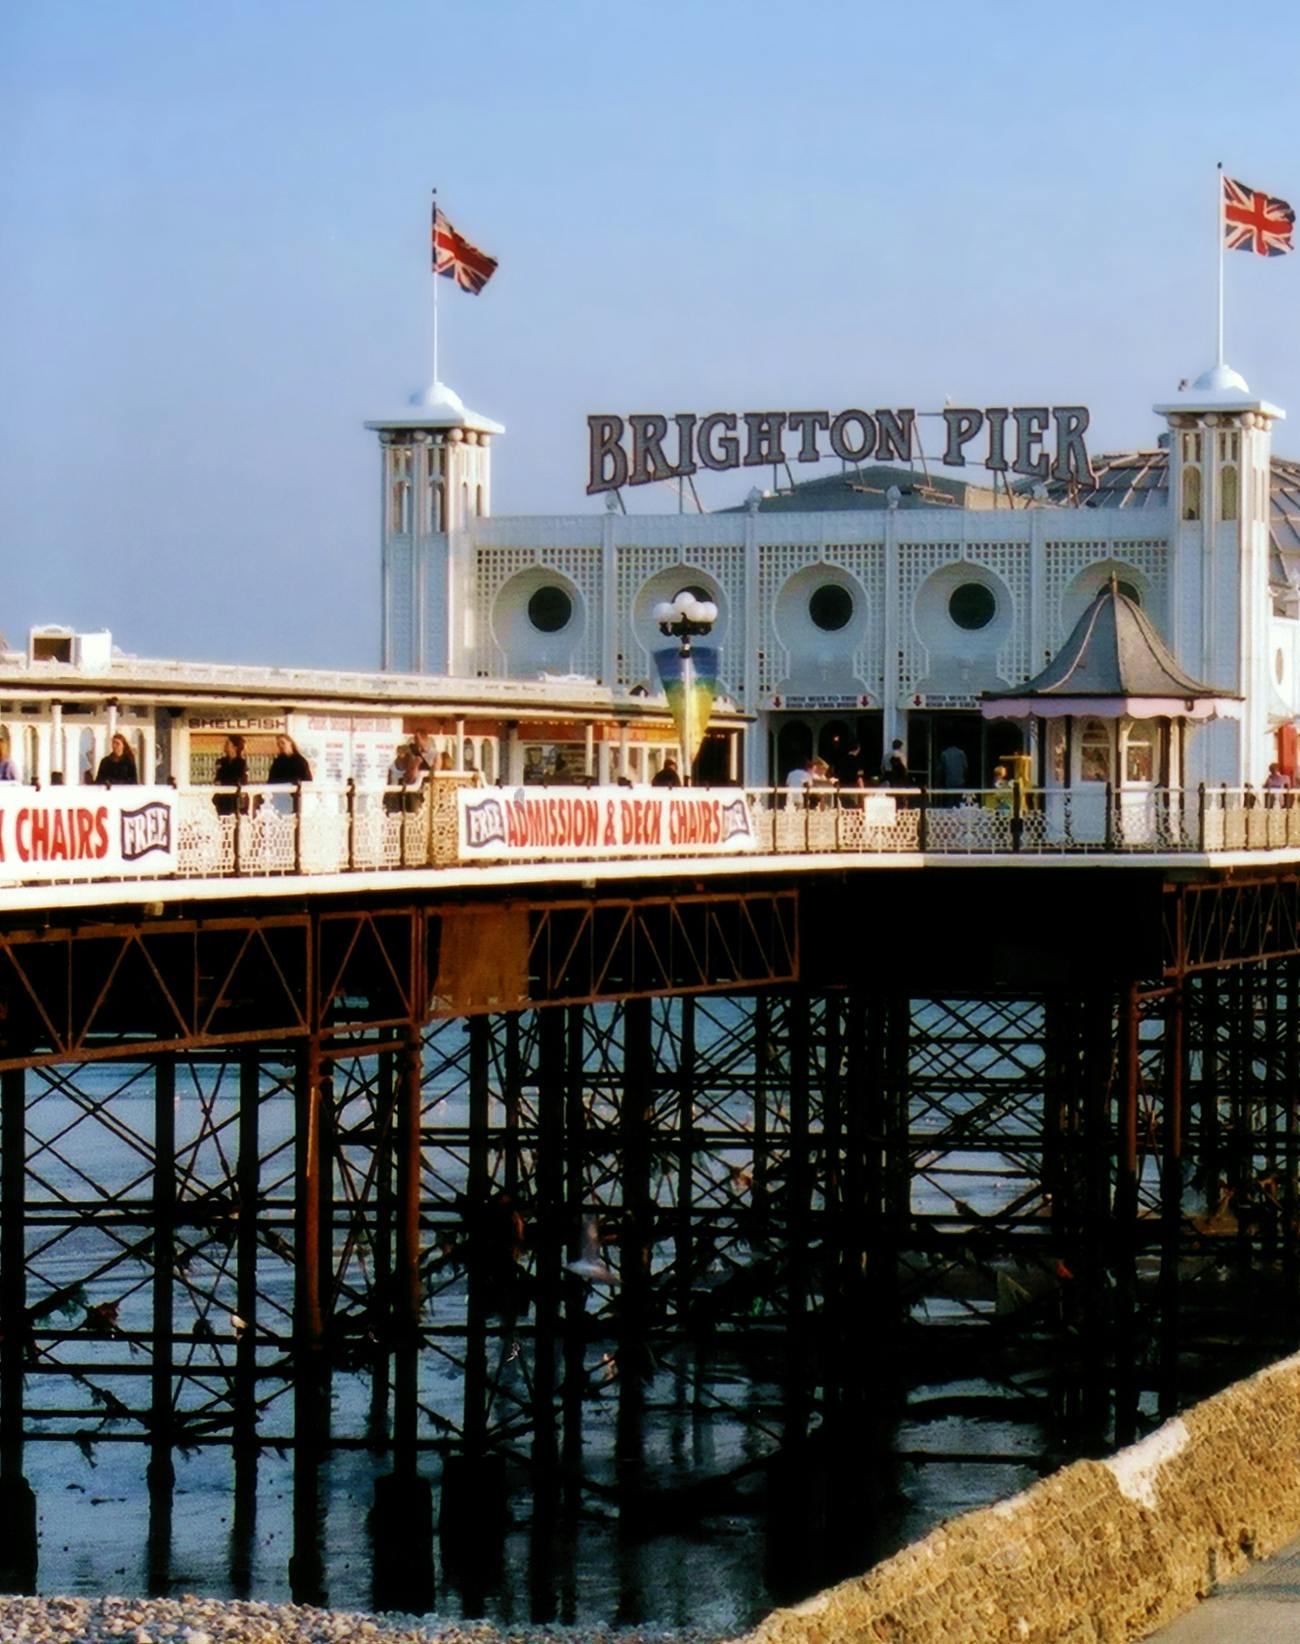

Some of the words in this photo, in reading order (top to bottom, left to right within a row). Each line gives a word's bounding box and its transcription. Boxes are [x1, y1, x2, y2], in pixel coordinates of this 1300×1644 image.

[586, 408, 915, 494] BRIGHTON
[943, 406, 1099, 490] PIER
[188, 717, 285, 729] SHELLFISH
[16, 806, 109, 863] CHAIRS
[122, 805, 170, 858] FREE
[504, 798, 599, 847] ADMISSION
[603, 799, 617, 846] &
[620, 798, 663, 845] DECK
[668, 798, 722, 844] CHAIRS
